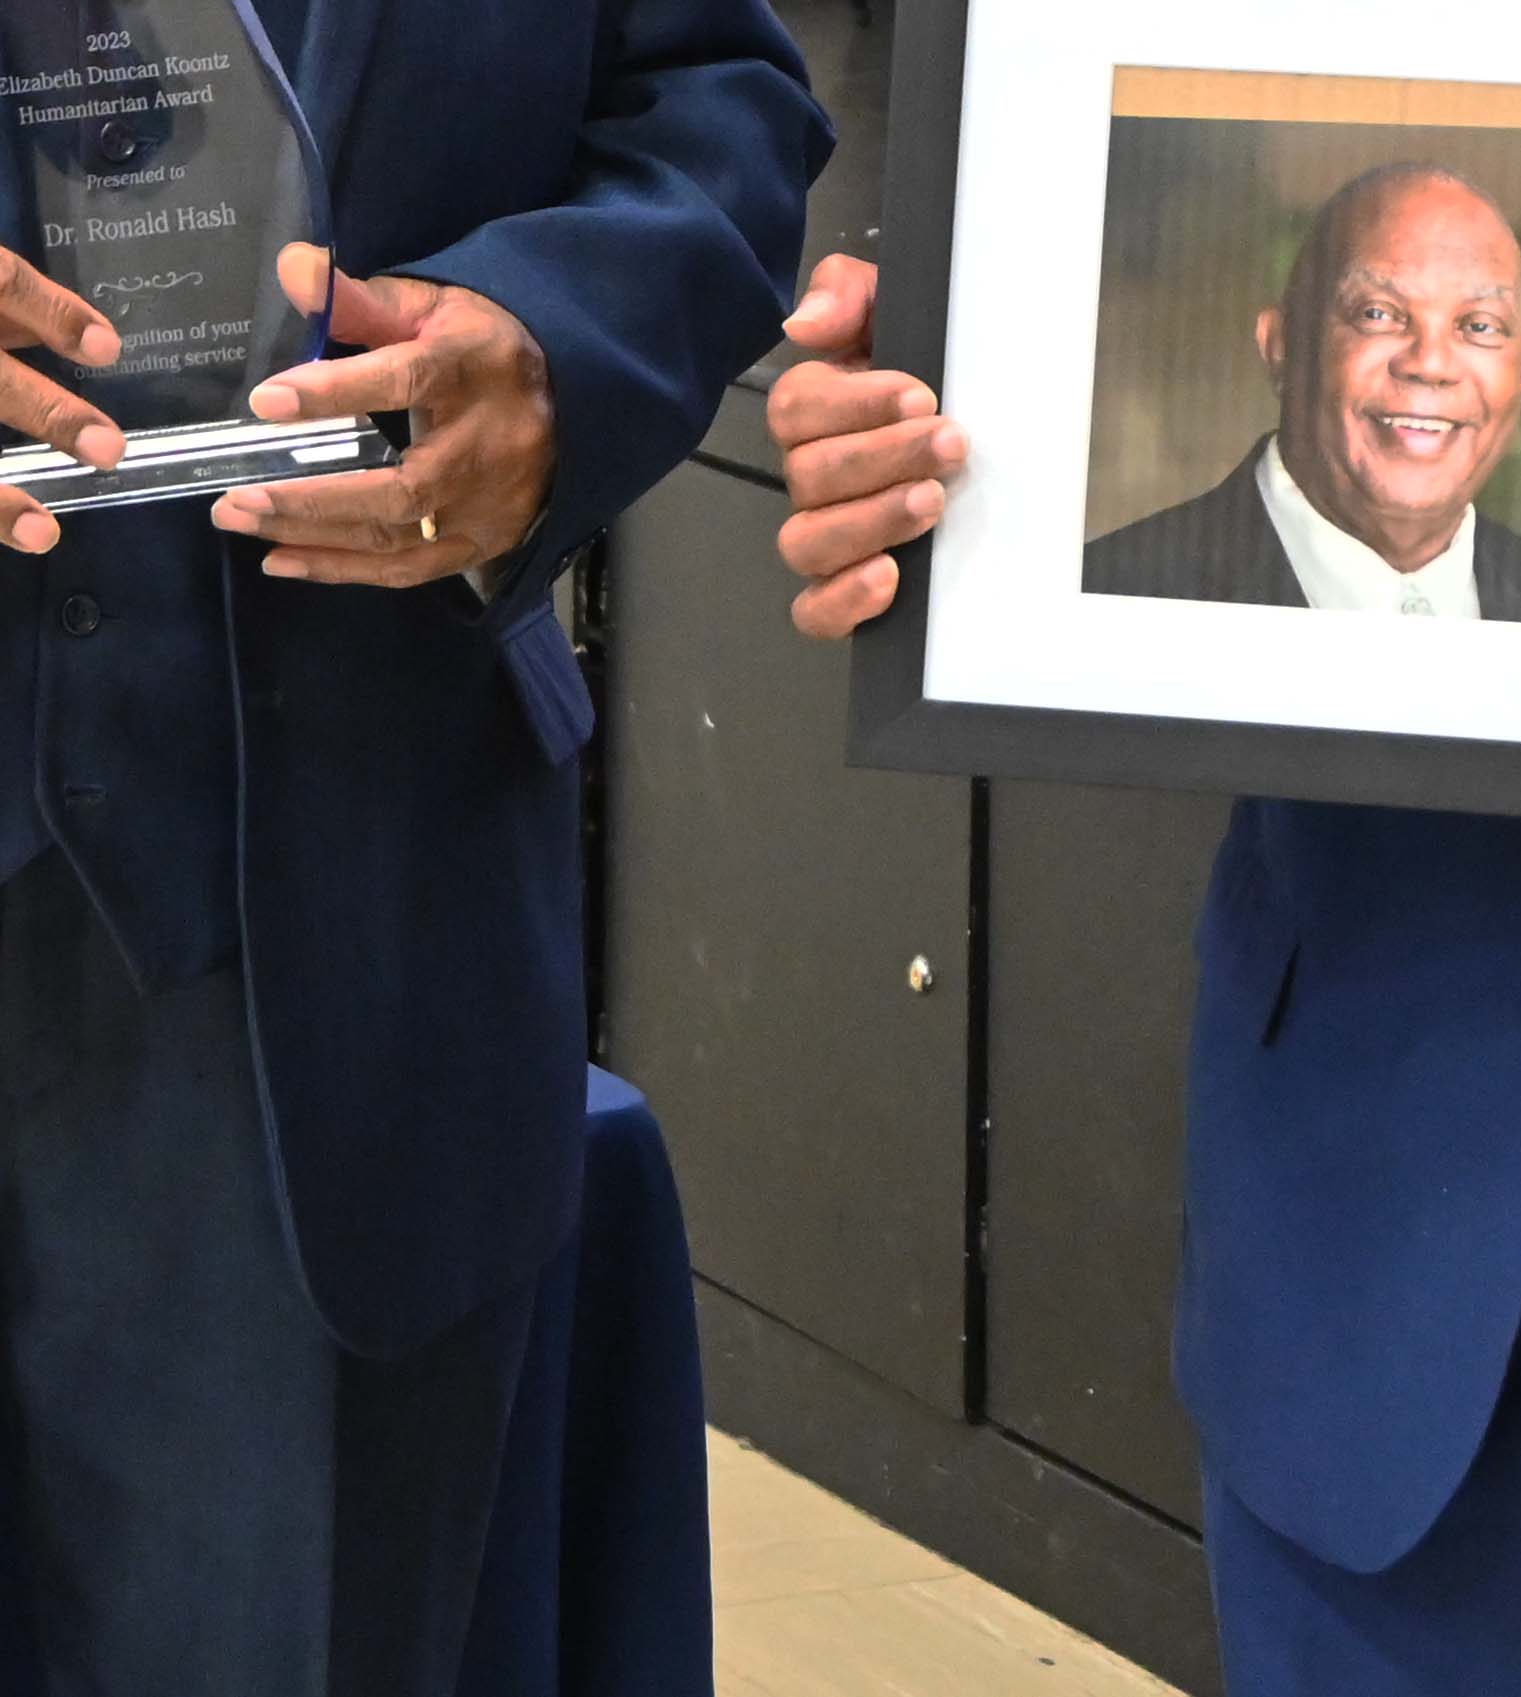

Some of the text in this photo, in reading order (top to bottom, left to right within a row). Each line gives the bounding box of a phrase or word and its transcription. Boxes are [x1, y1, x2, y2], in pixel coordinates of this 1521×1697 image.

[86, 31, 131, 52] 2023
[87, 61, 160, 85] Duncan
[164, 52, 230, 76] Koontz
[19, 84, 214, 125] Humanitarian Award
[86, 166, 186, 190] Presented to
[43, 202, 237, 248] Dr. Ronald Hash
[123, 319, 252, 353] gnition of your
[184, 345, 247, 365] service
